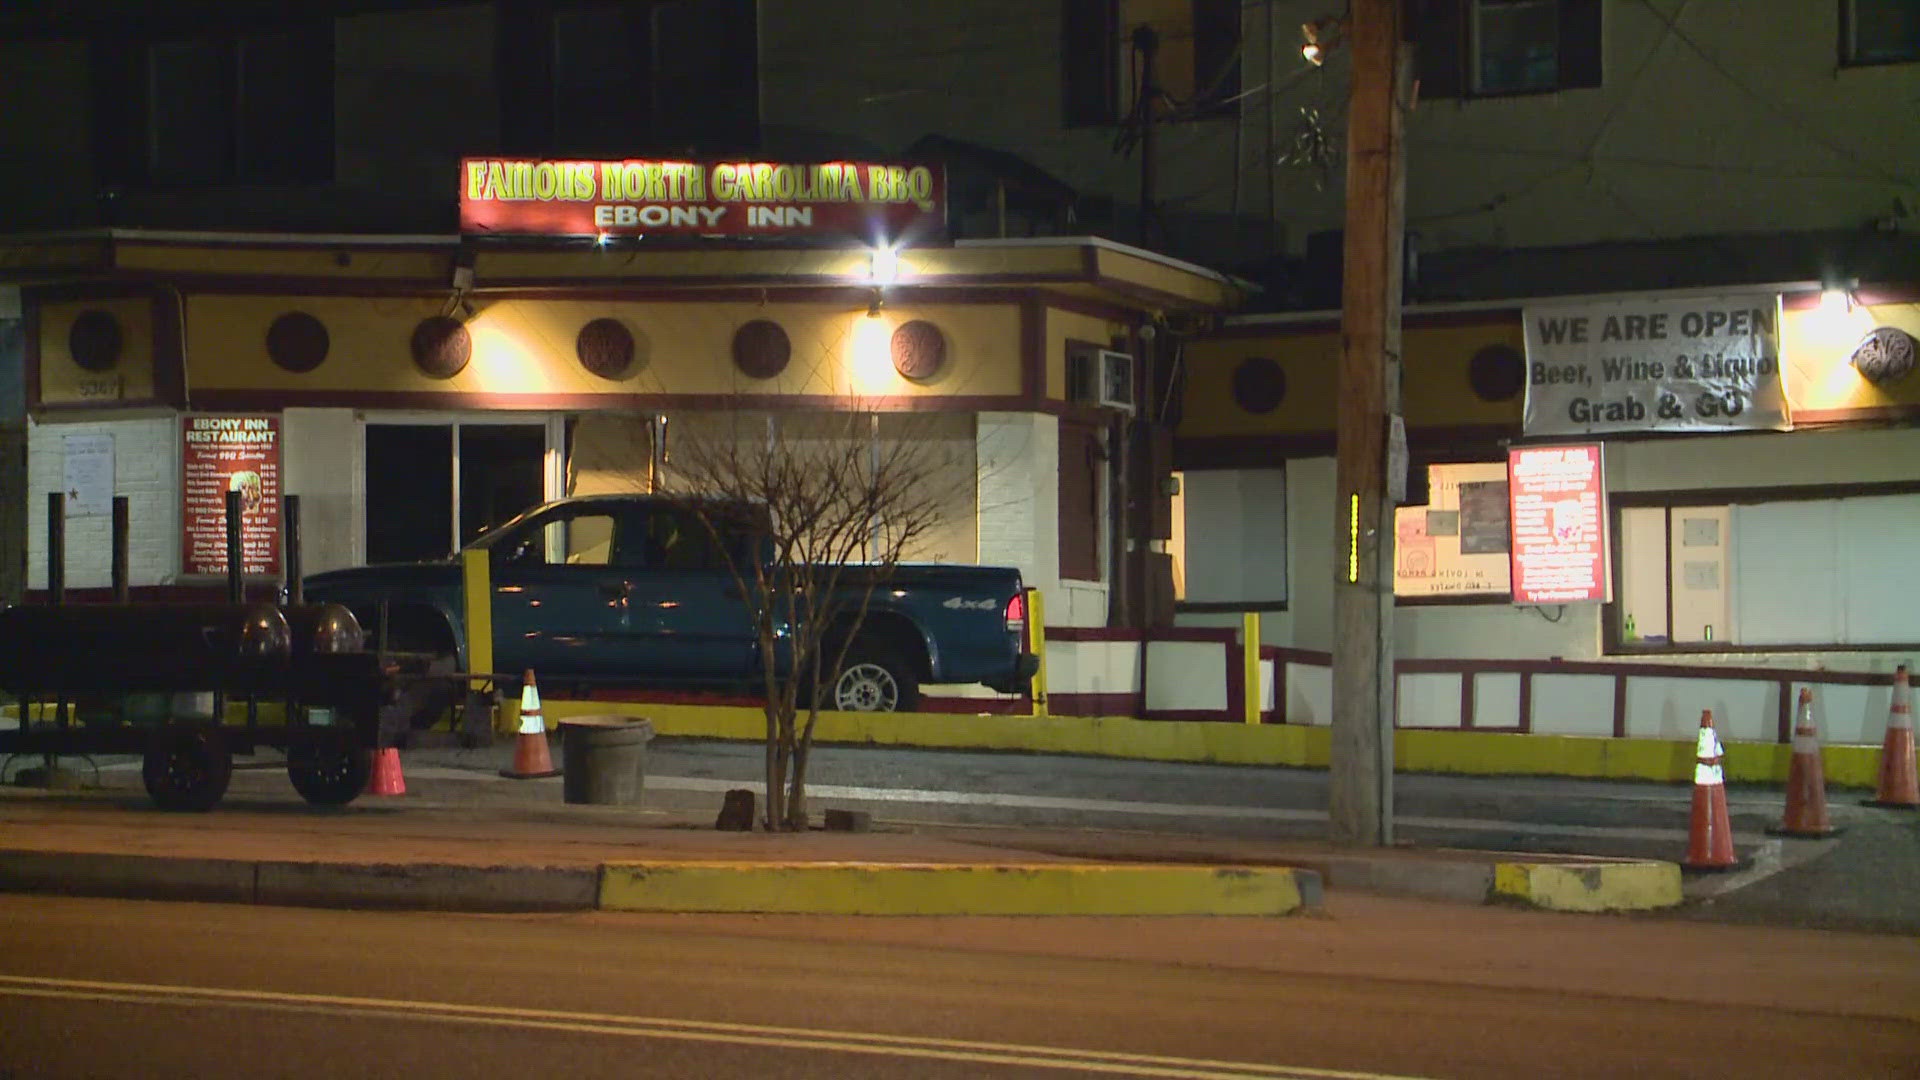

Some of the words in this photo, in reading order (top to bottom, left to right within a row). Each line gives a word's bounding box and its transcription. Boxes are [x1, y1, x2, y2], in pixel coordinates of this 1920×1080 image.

[467, 160, 597, 201] FAMOUS
[600, 161, 706, 201] NORTH
[711, 163, 862, 202] CAROLINA
[867, 165, 934, 209] BBQ
[594, 205, 726, 227] EBONY
[747, 205, 813, 227] INN
[1538, 317, 1588, 345] WE
[1601, 312, 1669, 342] ARE
[1680, 308, 1775, 339] OPEN
[1531, 360, 1593, 388] Beer,
[1602, 354, 1665, 382] Wine
[1673, 354, 1695, 379] &
[1568, 395, 1646, 424] Grab
[1656, 391, 1682, 420] &
[186, 430, 276, 443] RESTAURANT
[193, 418, 241, 431] EBONY
[244, 418, 269, 431] INN
